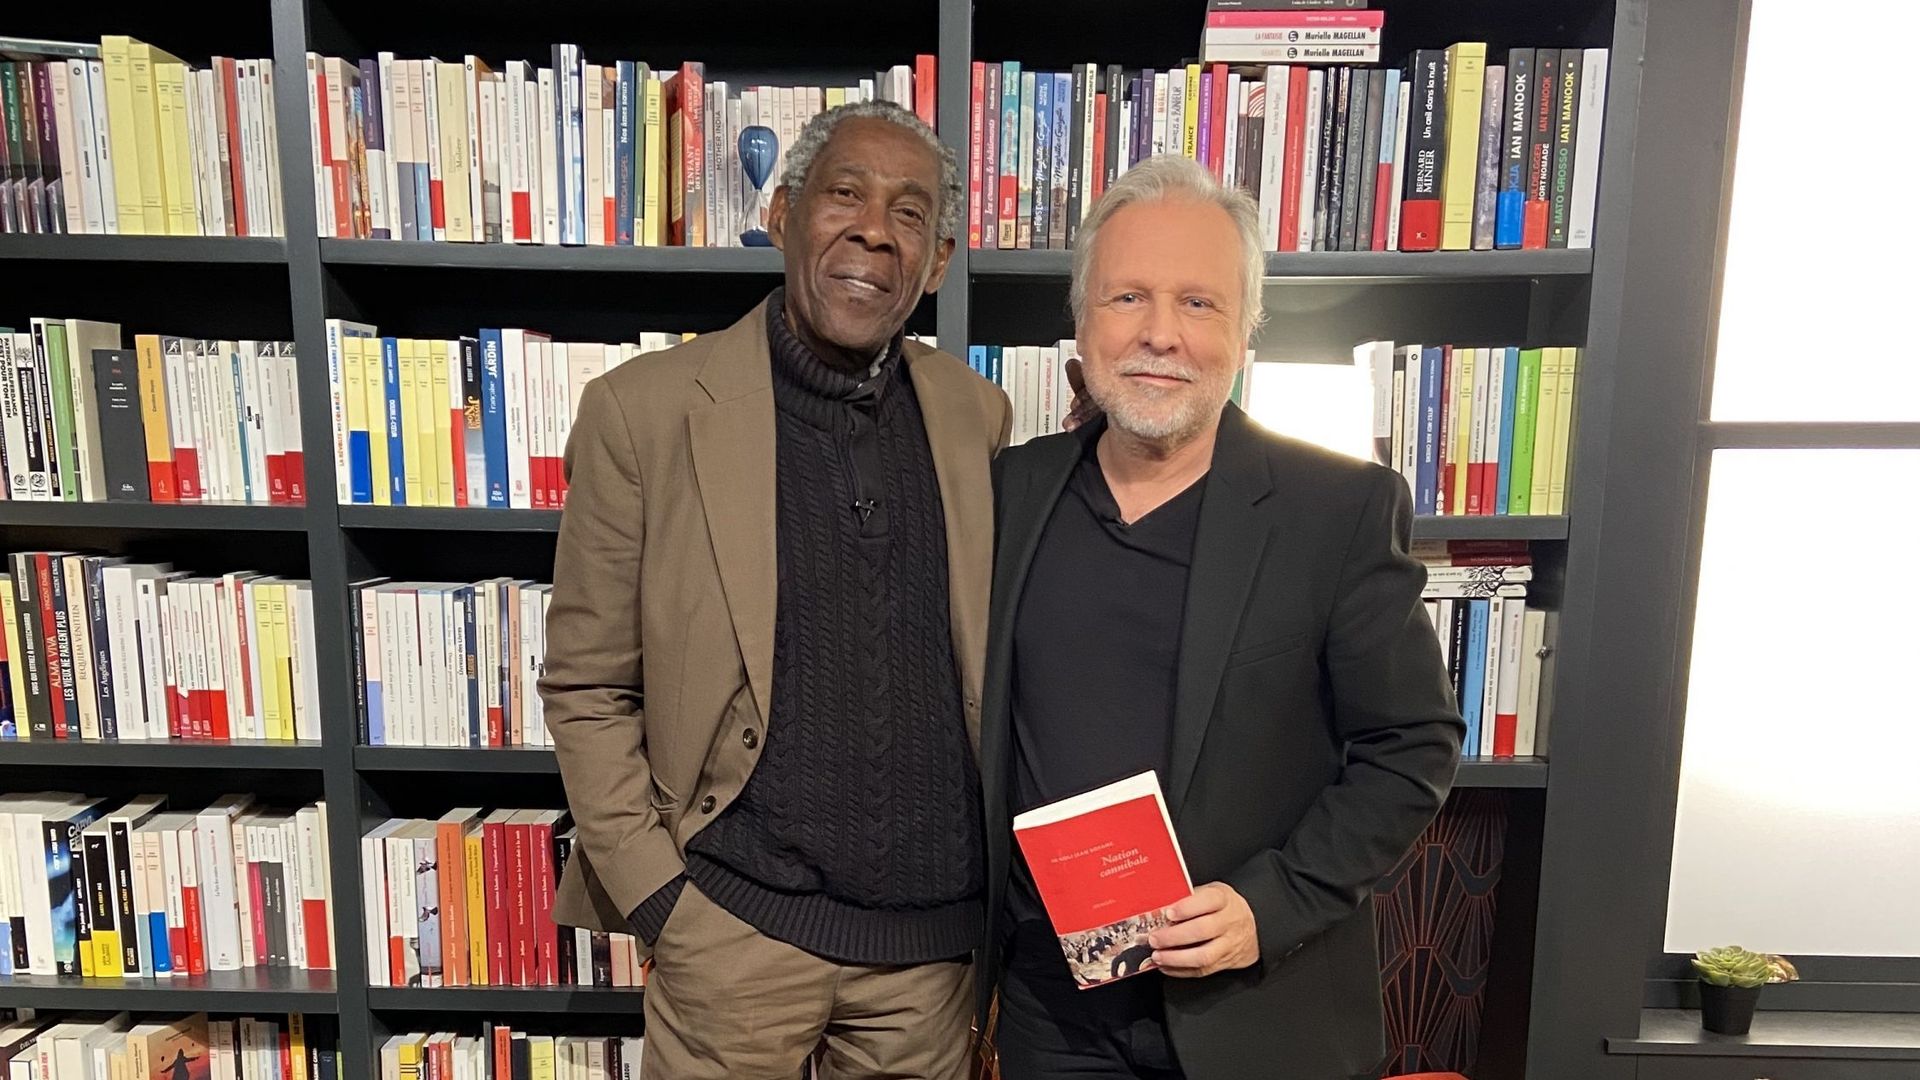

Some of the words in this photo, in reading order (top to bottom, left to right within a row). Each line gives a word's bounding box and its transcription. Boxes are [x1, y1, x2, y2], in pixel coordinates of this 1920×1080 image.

[1428, 62, 1436, 78] nuit
[1427, 80, 1434, 88] la
[1540, 76, 1551, 114] MANOOK
[1426, 90, 1434, 109] dans
[1514, 73, 1526, 132] MANOOK
[1561, 72, 1574, 120] MANOOK
[1423, 126, 1431, 138] Un
[1539, 116, 1548, 132] IAN
[1560, 124, 1569, 143] IAN
[1510, 136, 1522, 158] IAN
[687, 144, 695, 193] L'ENFANT
[1415, 150, 1425, 192] BERNARD
[1424, 149, 1435, 192] MINIER
[1539, 143, 1549, 179] NOMADE
[1556, 148, 1568, 192] GROSSO
[1554, 195, 1564, 224] MATO
[4, 338, 12, 366] PATRICK
[487, 341, 497, 378] JARDIN
[4, 400, 12, 418] BIEN
[40, 569, 48, 586] ENGEL
[51, 558, 59, 575] ENGEL
[53, 576, 61, 596] VINCENT
[42, 587, 51, 610] VINCENT
[56, 610, 67, 628] PLUS
[72, 604, 83, 642] VÉNITIEN
[47, 635, 58, 658] VIVA
[59, 629, 70, 657] PARLENT
[29, 655, 37, 672] ENTREZ
[51, 659, 61, 688] ALMA
[62, 658, 71, 667] NE
[77, 644, 87, 680] REQUIEM
[98, 650, 110, 685] Angéliques
[63, 668, 73, 687] VIEUX
[65, 688, 74, 701] LES
[101, 687, 109, 697] Les
[1099, 855, 1149, 878] cannibale
[1102, 847, 1139, 867] Nation
